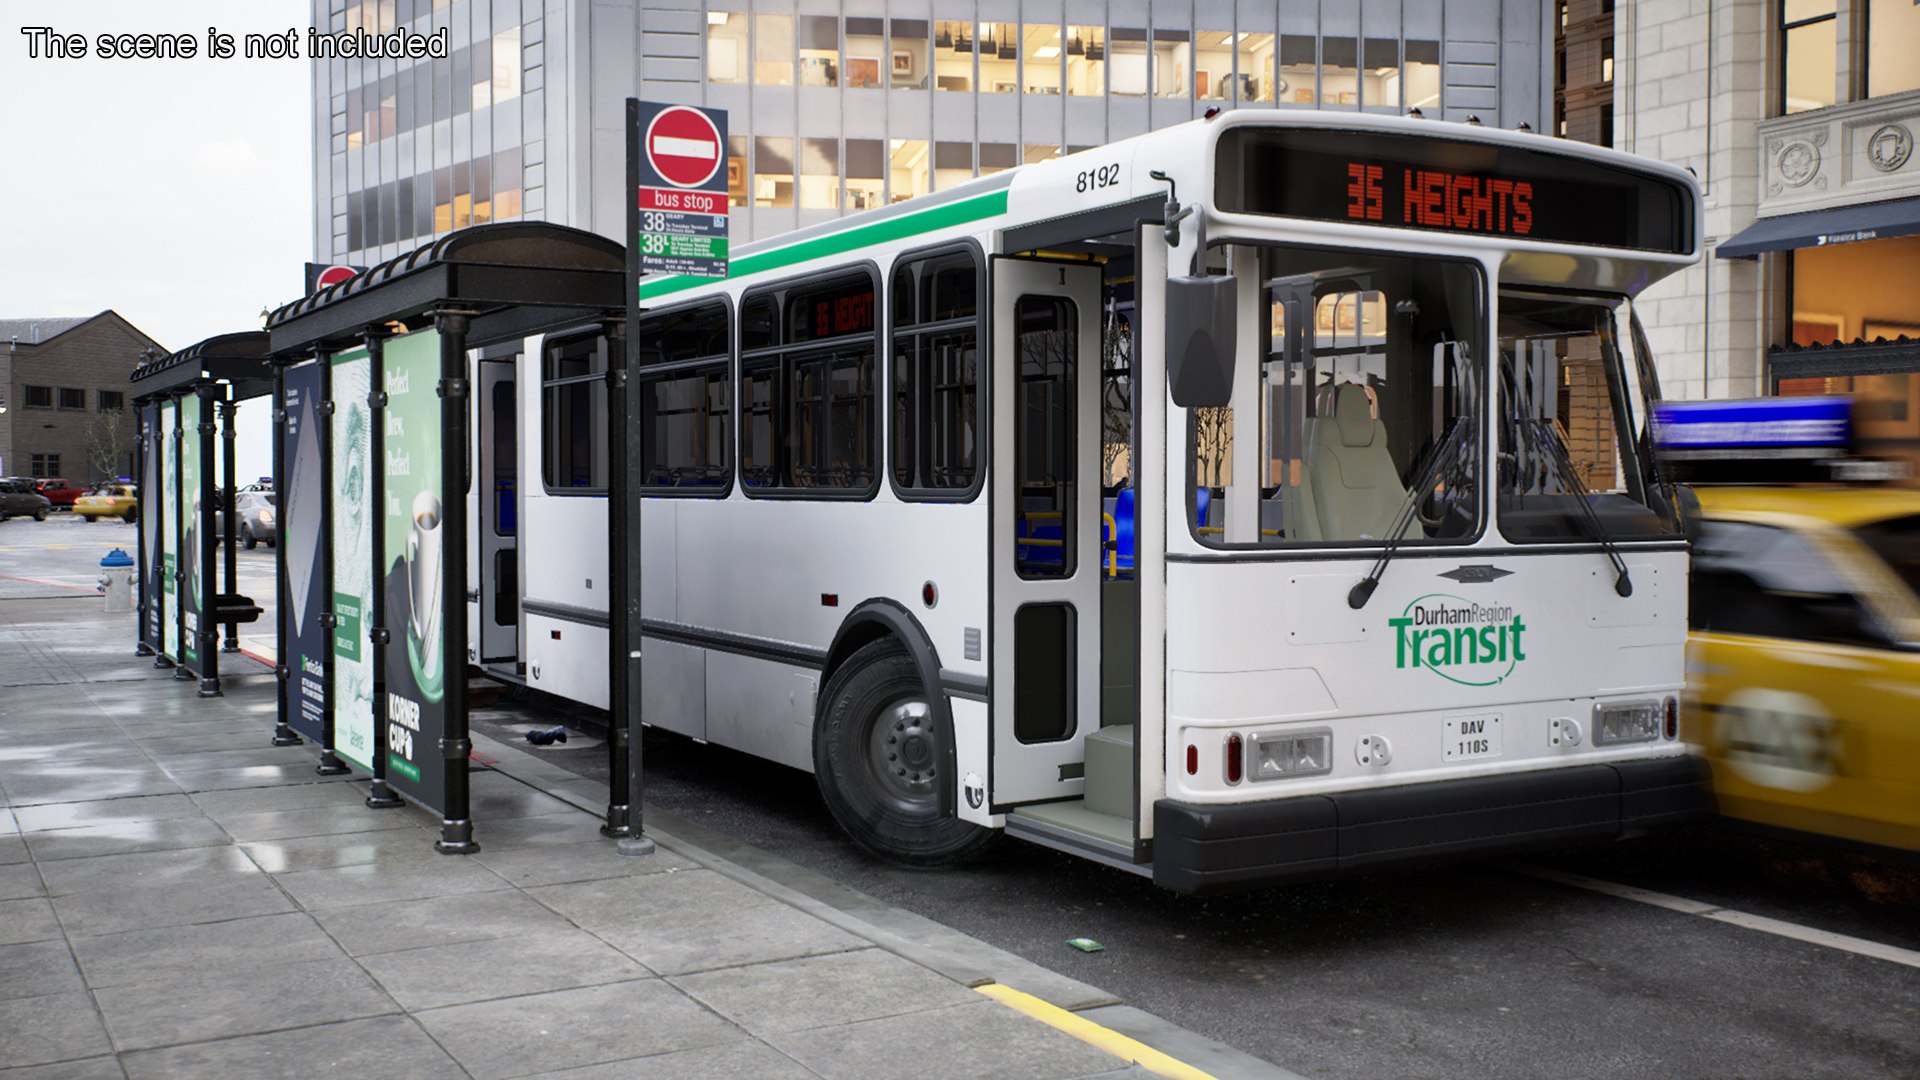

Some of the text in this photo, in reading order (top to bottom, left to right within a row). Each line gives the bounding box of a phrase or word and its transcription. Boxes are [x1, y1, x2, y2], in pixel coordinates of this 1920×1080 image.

[1076, 163, 1120, 193] 8192
[655, 189, 713, 212] bus stop
[1348, 163, 1533, 234] 35 HEIGHTS
[644, 212, 665, 232] 38
[643, 256, 664, 265] Fares:
[816, 291, 874, 337] 35 HEIGHT
[386, 367, 409, 396] Perfect
[387, 448, 410, 476] Perfect
[1388, 614, 1526, 669] Transit
[389, 692, 420, 732] KORNER
[389, 723, 405, 754] CUP
[1461, 720, 1485, 735] DAV
